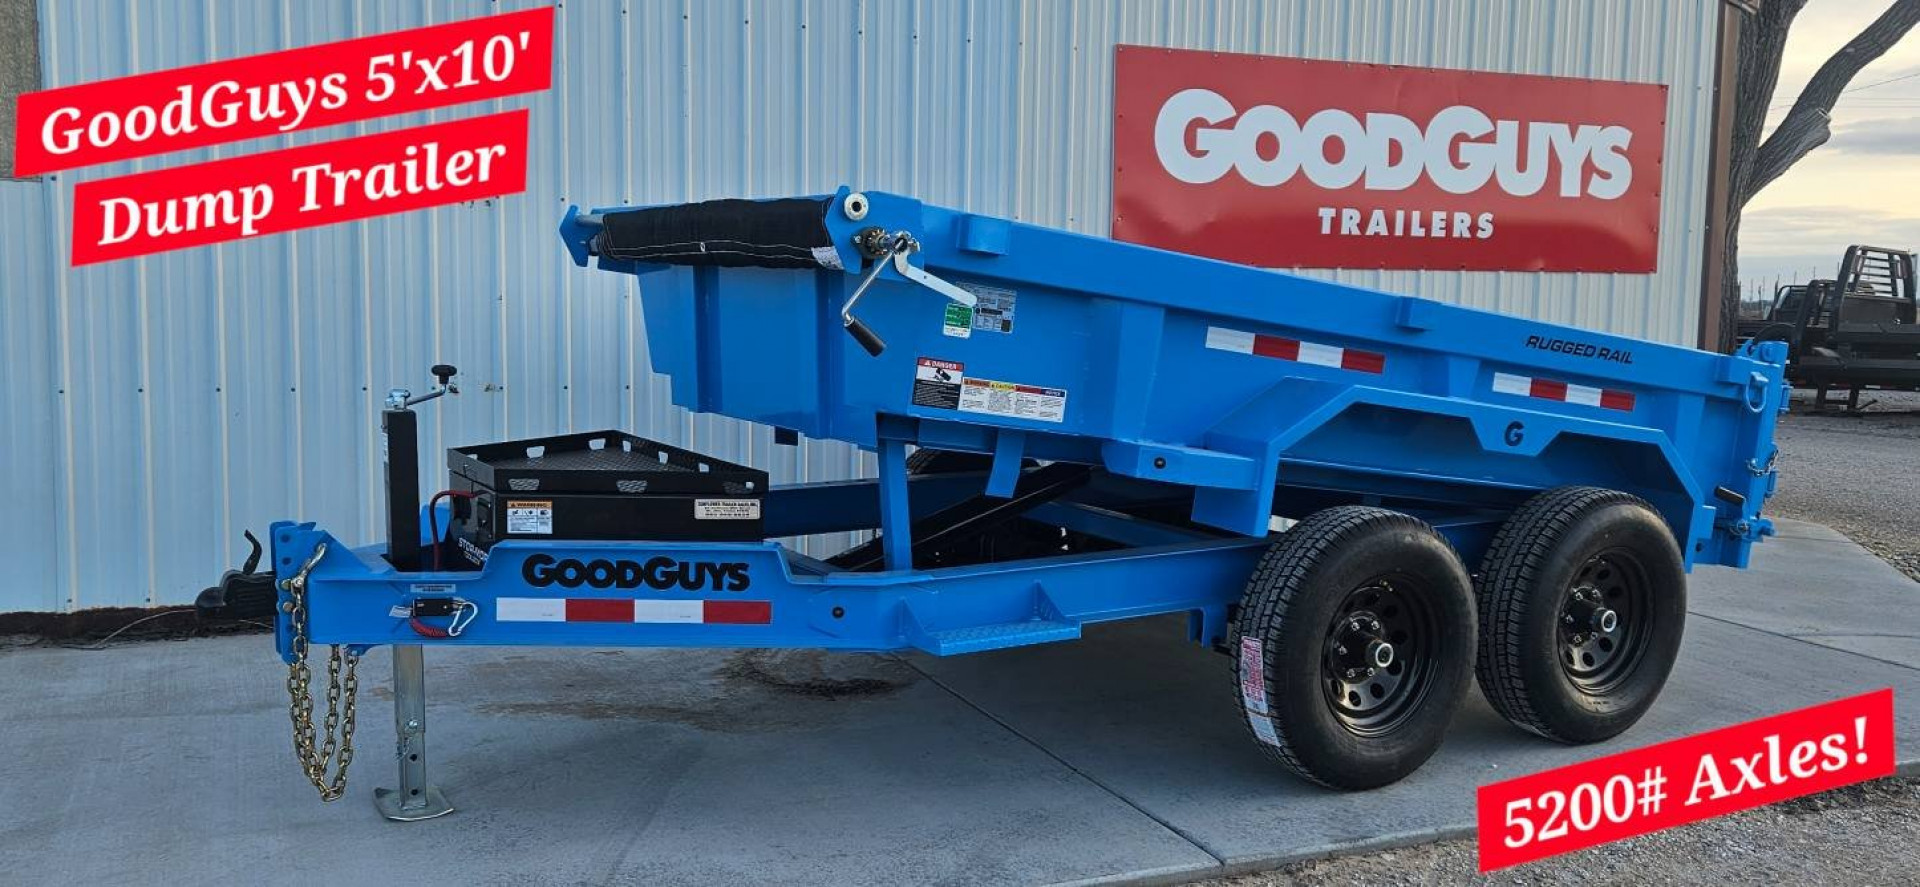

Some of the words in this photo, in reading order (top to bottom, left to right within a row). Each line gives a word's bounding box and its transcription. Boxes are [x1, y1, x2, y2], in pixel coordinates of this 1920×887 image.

[1154, 88, 1633, 200] GOODGUYS
[1318, 207, 1495, 239] TRAILERS
[1526, 335, 1597, 358] RUGGED
[1597, 347, 1632, 364] RAIL
[1504, 421, 1524, 447] G
[521, 553, 751, 592] GOODGUYS
